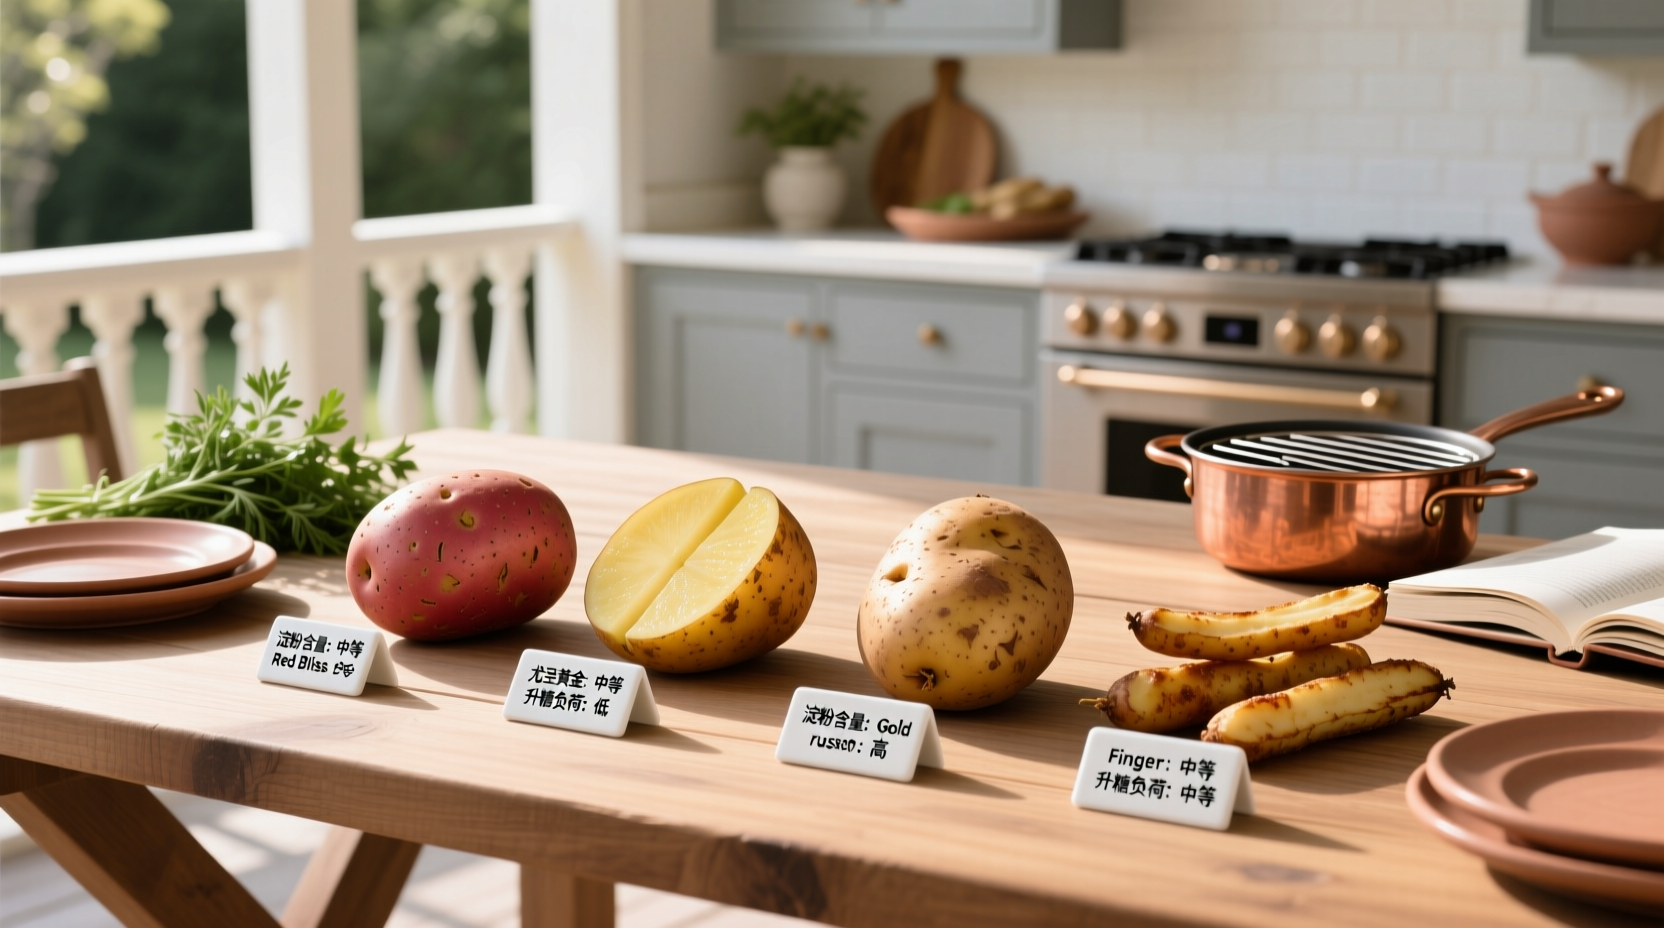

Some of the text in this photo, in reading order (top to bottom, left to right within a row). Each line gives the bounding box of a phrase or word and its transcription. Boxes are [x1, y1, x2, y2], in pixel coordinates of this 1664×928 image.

[271, 652, 296, 668] Red
[877, 718, 912, 737] Gold
[1108, 748, 1217, 781] Finger: 中等
[1180, 784, 1217, 808] 中等
